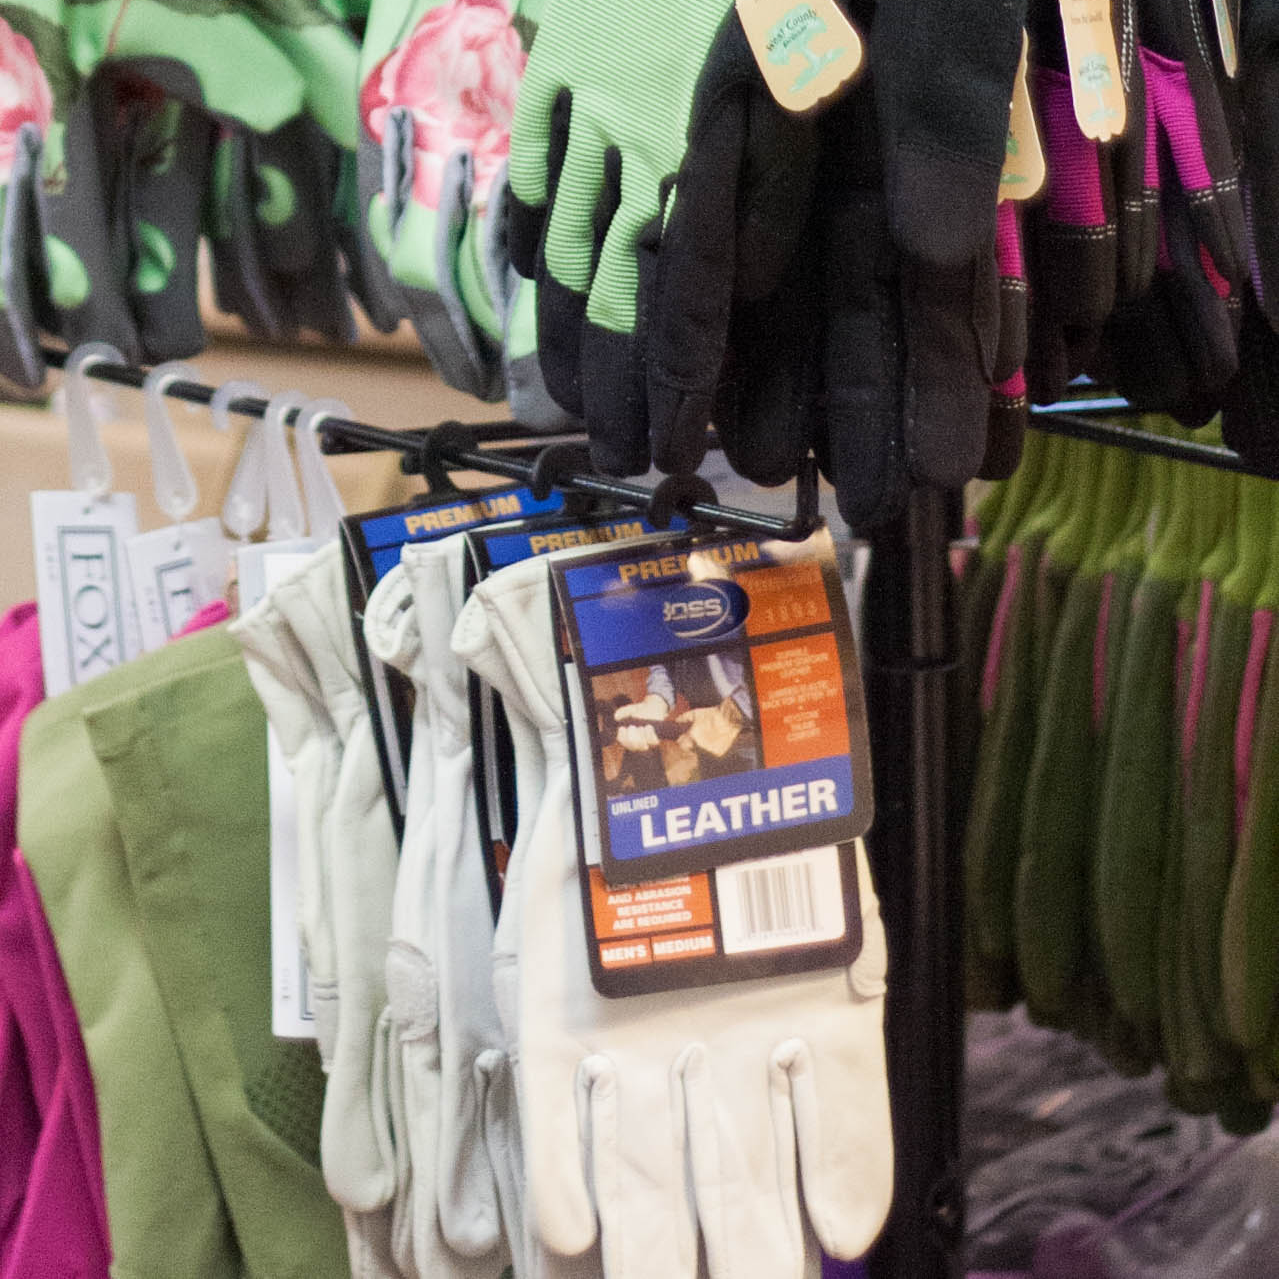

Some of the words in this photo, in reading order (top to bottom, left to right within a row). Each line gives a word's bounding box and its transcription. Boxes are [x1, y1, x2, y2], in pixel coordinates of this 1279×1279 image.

[404, 494, 522, 535] PREMIUM
[529, 521, 644, 555] PREMIUM
[70, 553, 115, 670] FOX
[611, 795, 658, 817] UNLINED
[639, 778, 838, 848] LEATHER
[634, 885, 692, 901] ABRASION
[613, 918, 635, 931] ARE
[637, 910, 693, 928] REQUIRED
[616, 899, 685, 917] RESISTANCE
[601, 944, 647, 962] MEN'S
[652, 935, 713, 955] MEDIUM
